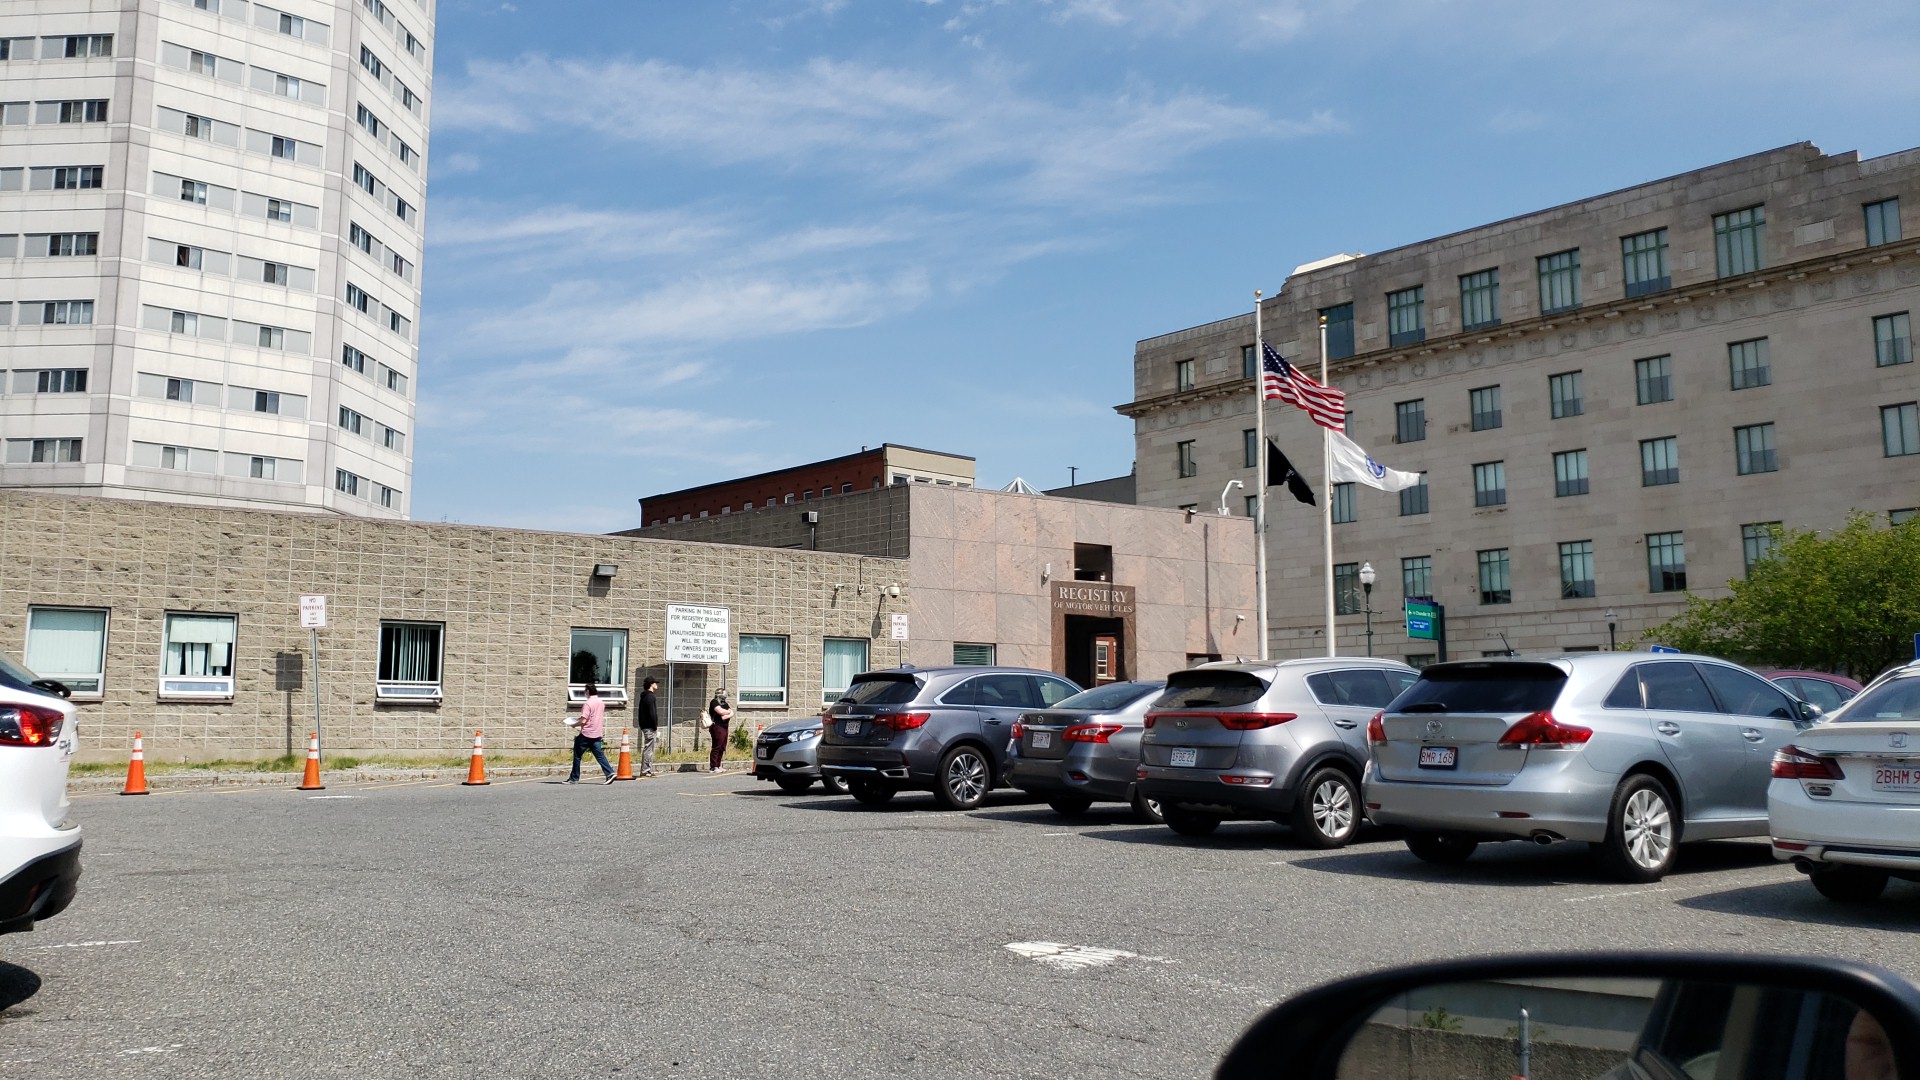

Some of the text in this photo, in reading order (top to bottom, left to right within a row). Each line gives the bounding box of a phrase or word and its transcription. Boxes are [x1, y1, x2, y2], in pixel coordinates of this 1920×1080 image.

[1058, 586, 1128, 603] REGISTRY
[1053, 600, 1133, 613] OF MOTOR VEHICLES
[704, 616, 726, 624] BUSINESS
[691, 622, 707, 630] ONLY
[669, 629, 727, 639] UNAUTHORIZED VEHICLES
[1875, 769, 1910, 785] 2BHM
